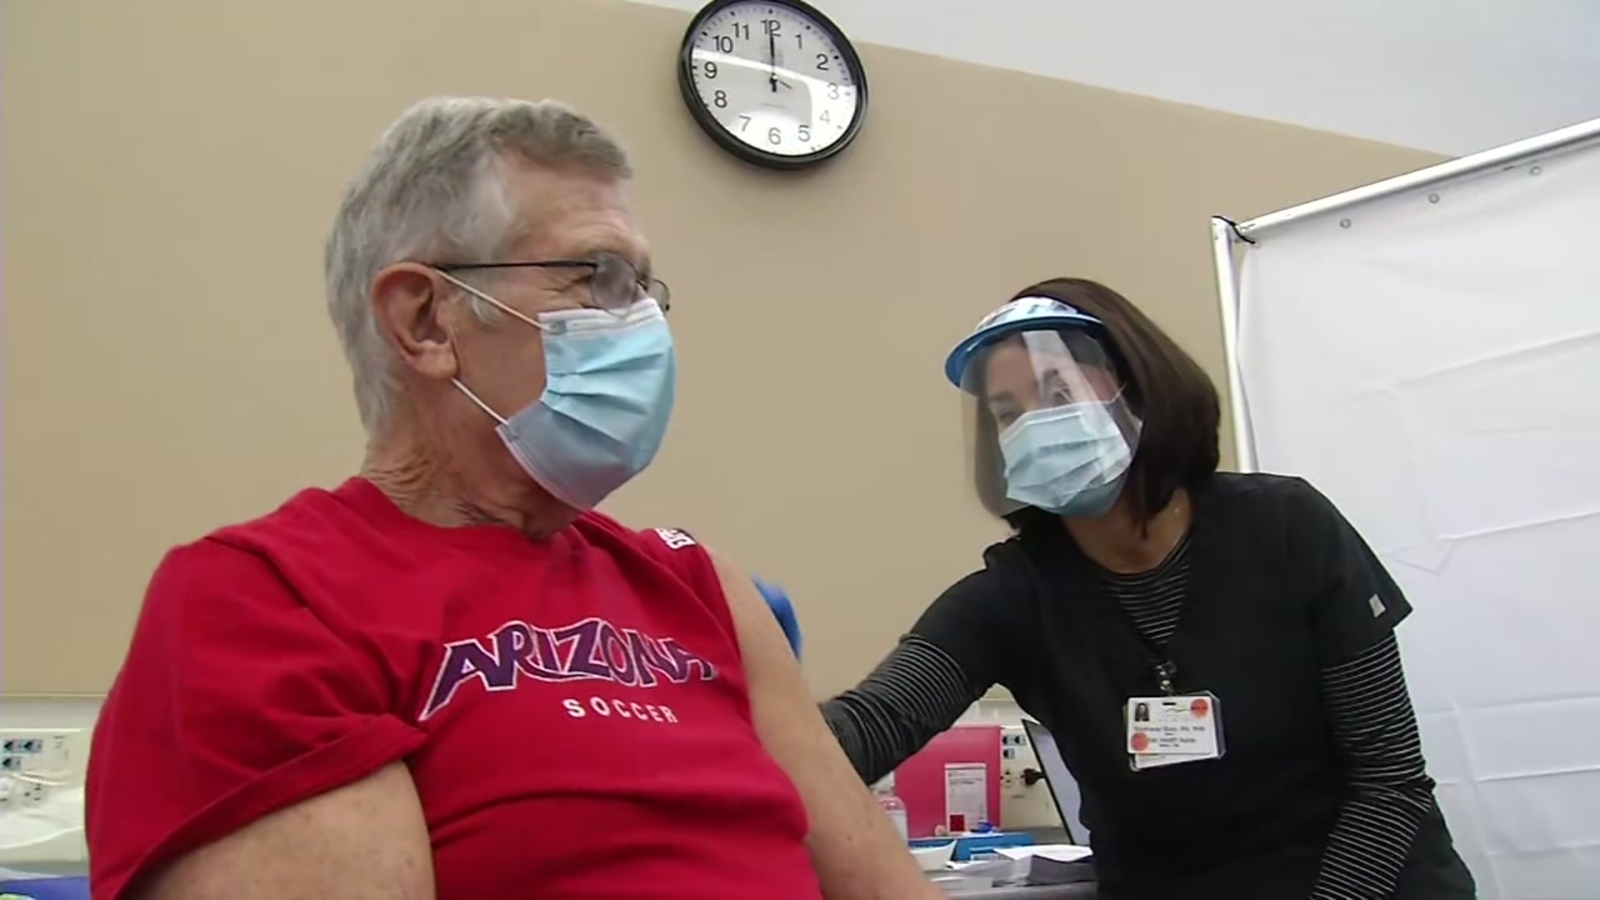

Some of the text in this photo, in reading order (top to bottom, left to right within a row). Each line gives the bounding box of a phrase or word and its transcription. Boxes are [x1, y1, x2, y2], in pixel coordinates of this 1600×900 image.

[732, 22, 750, 40] 11
[761, 19, 781, 37] 12
[712, 35, 734, 54] 10
[795, 33, 802, 50] 1
[704, 61, 718, 79] 9
[816, 53, 829, 71] 2
[714, 90, 728, 108] 8
[826, 82, 840, 100] 3
[738, 115, 751, 132] 7
[819, 109, 831, 124] 4
[768, 127, 782, 145] 6
[798, 124, 811, 142] 5
[563, 696, 678, 724] SOCCER
